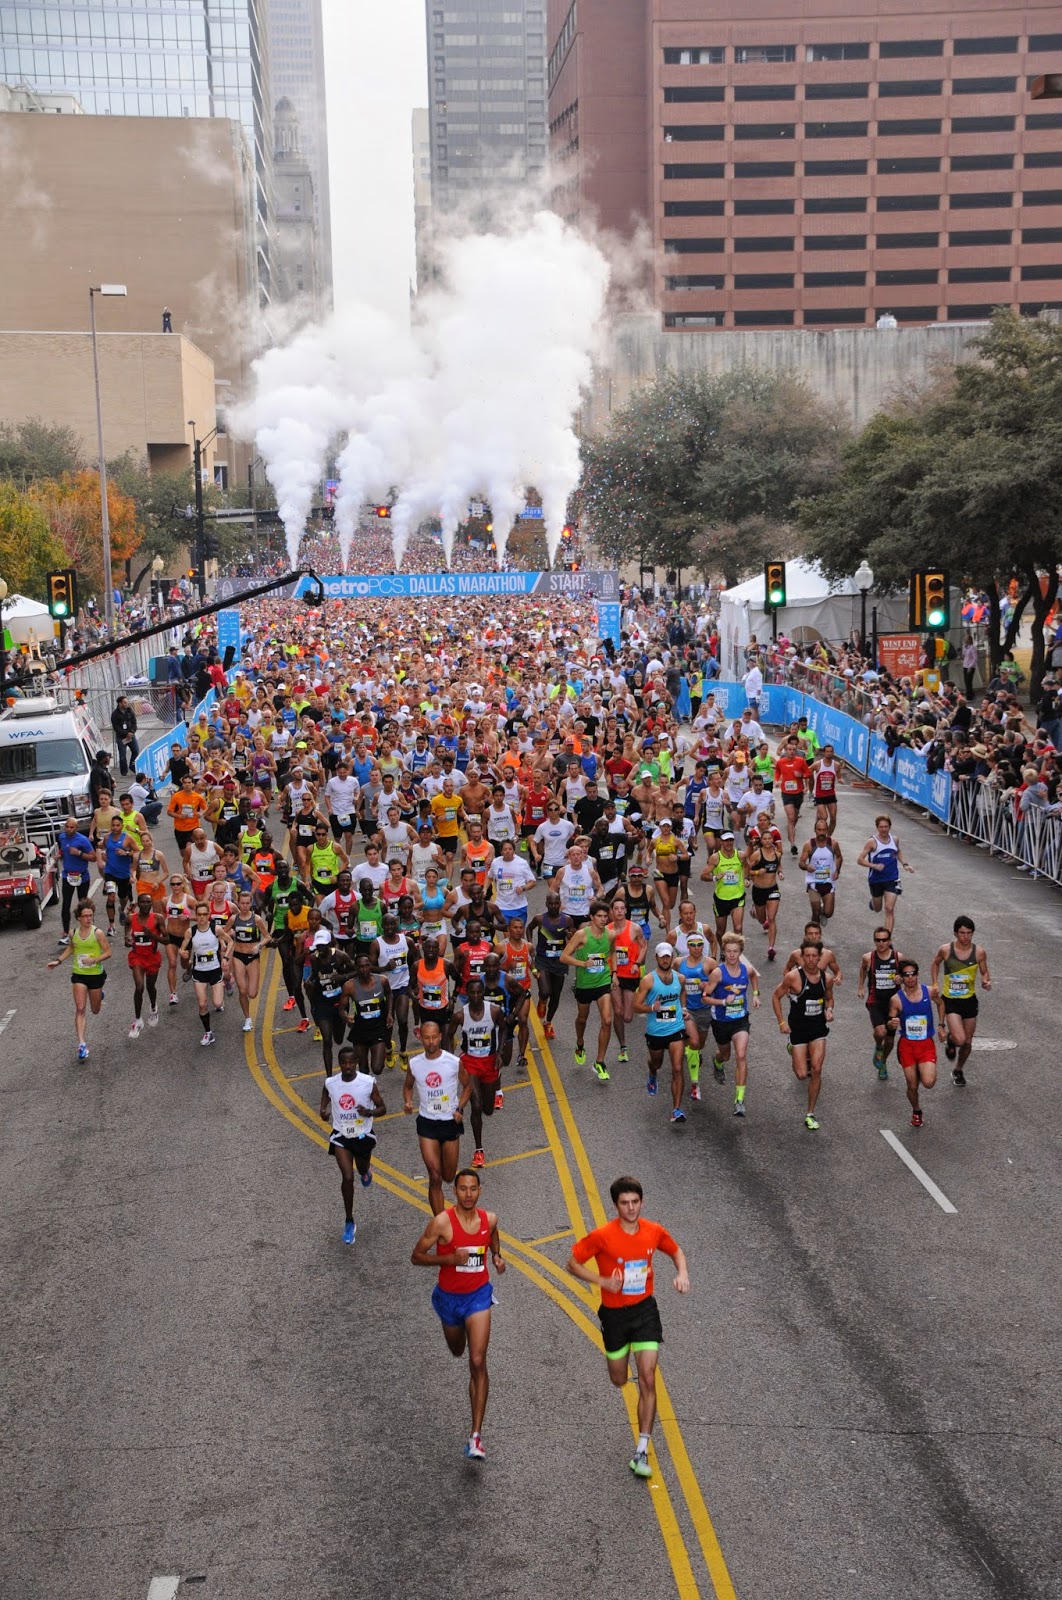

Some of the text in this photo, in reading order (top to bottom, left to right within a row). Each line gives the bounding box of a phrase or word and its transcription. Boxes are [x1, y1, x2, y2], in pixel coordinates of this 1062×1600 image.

[409, 577, 455, 593] DALLAS
[458, 575, 526, 591] MARATHON
[550, 574, 586, 591] START
[883, 640, 917, 648] WEST END
[9, 729, 44, 740] WFAA
[339, 1112, 358, 1121] PACER
